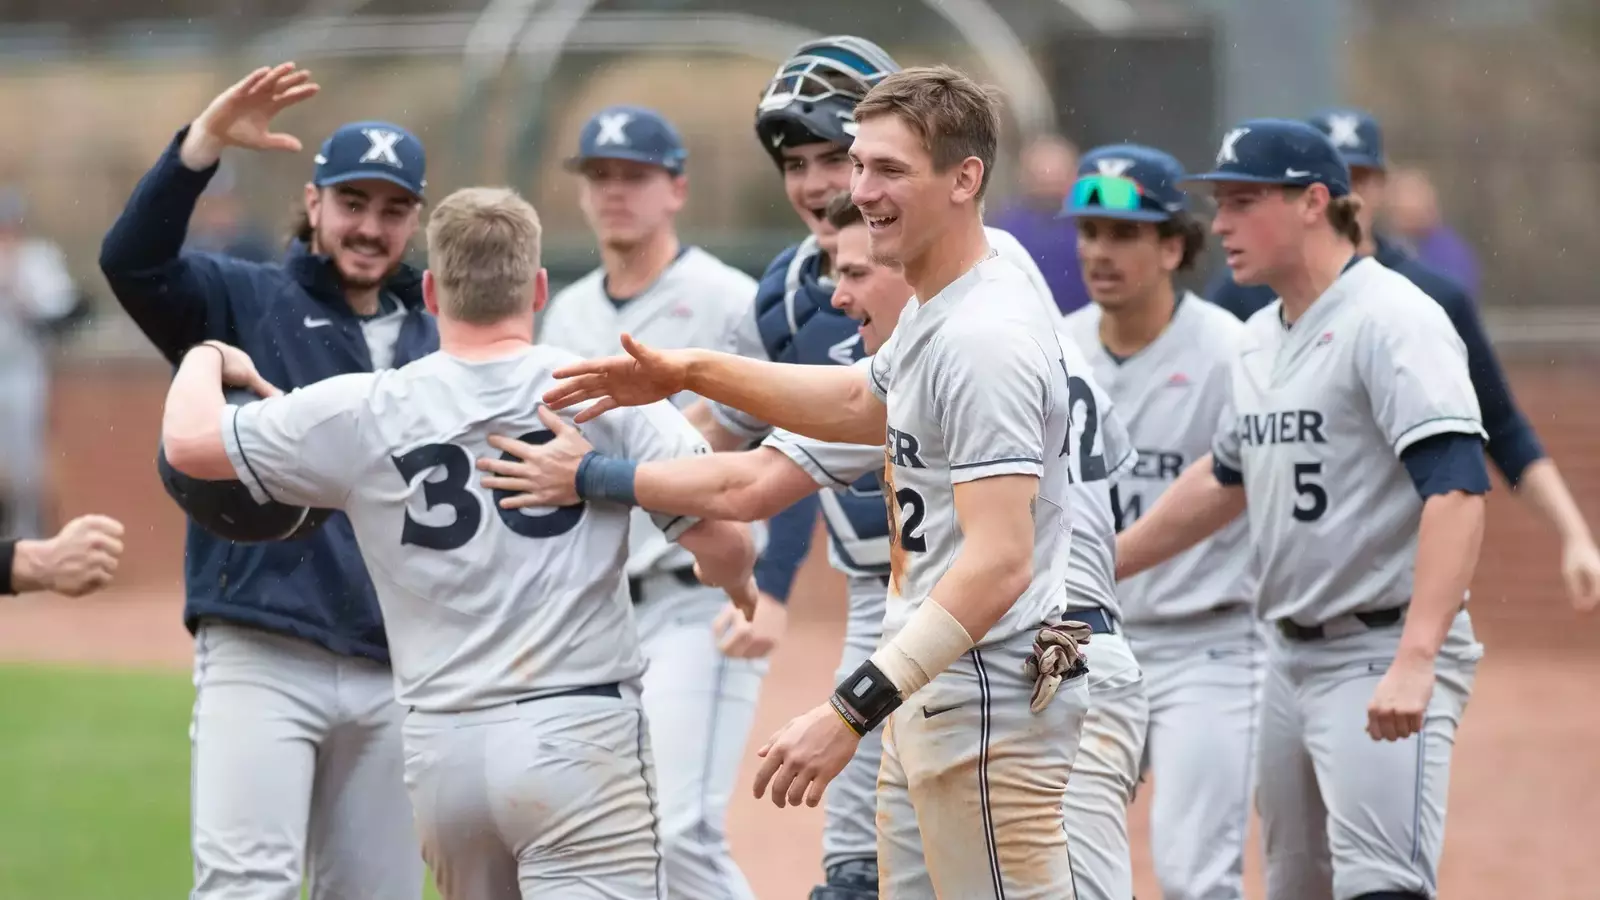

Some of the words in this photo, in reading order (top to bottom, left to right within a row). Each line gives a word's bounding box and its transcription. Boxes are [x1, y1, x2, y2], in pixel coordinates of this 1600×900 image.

[359, 127, 404, 169] X
[595, 112, 630, 147] X
[1326, 113, 1361, 149] X
[1239, 409, 1328, 446] AVIER
[1292, 462, 1329, 522] 5
